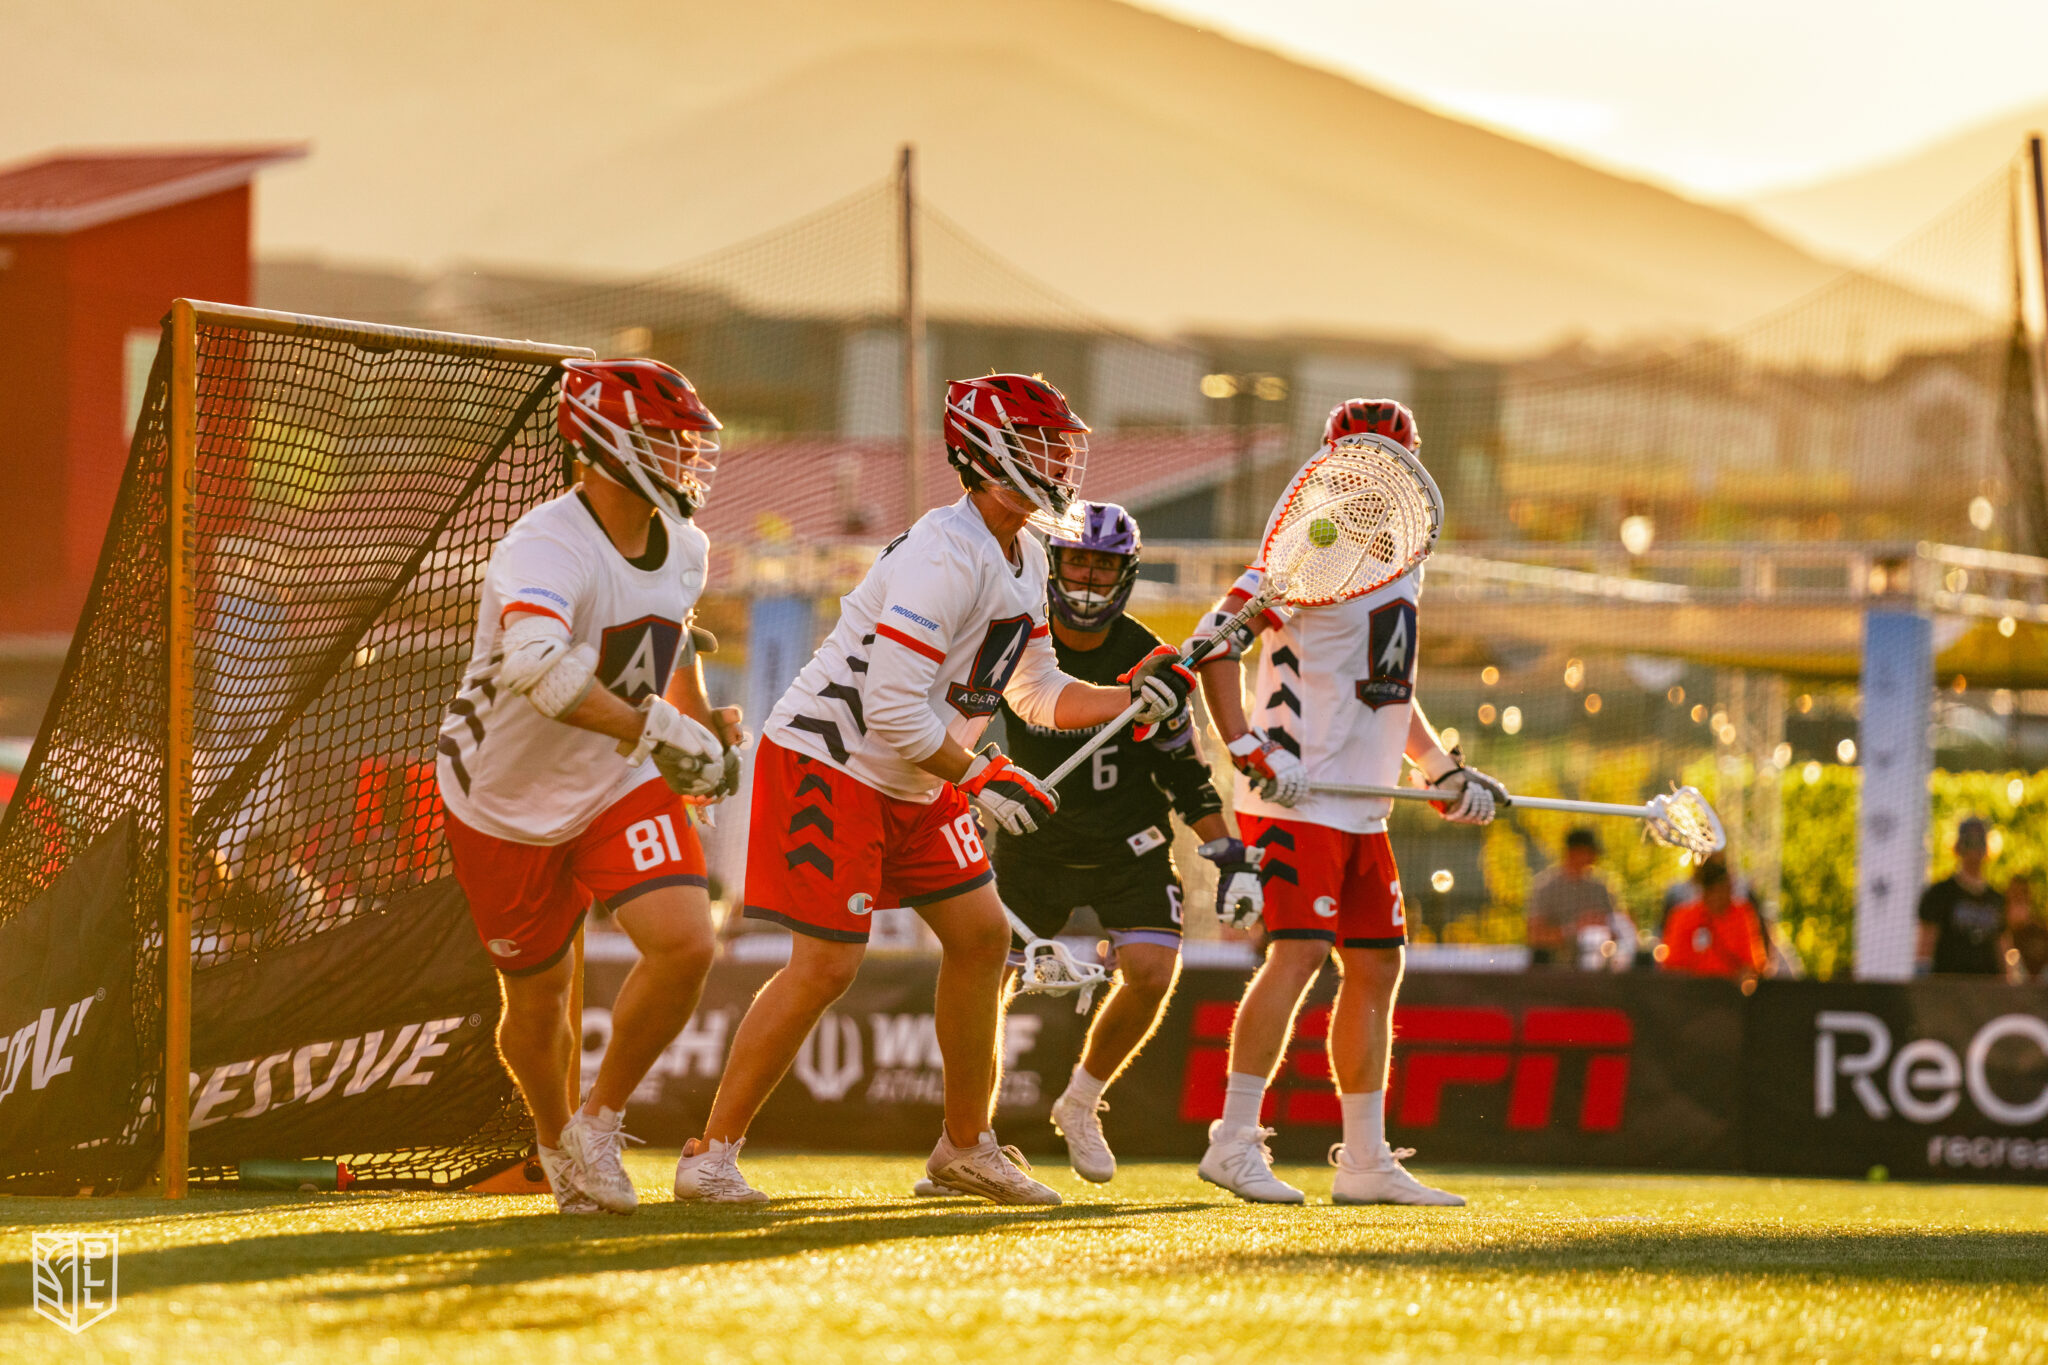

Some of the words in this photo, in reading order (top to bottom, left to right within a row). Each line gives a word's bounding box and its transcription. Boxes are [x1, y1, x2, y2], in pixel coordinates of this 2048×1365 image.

[890, 604, 940, 632] PROGRESSIVE
[1092, 744, 1119, 791] 6
[625, 813, 682, 872] 81
[939, 812, 984, 870] 18
[1180, 1002, 1634, 1132] ESPN
